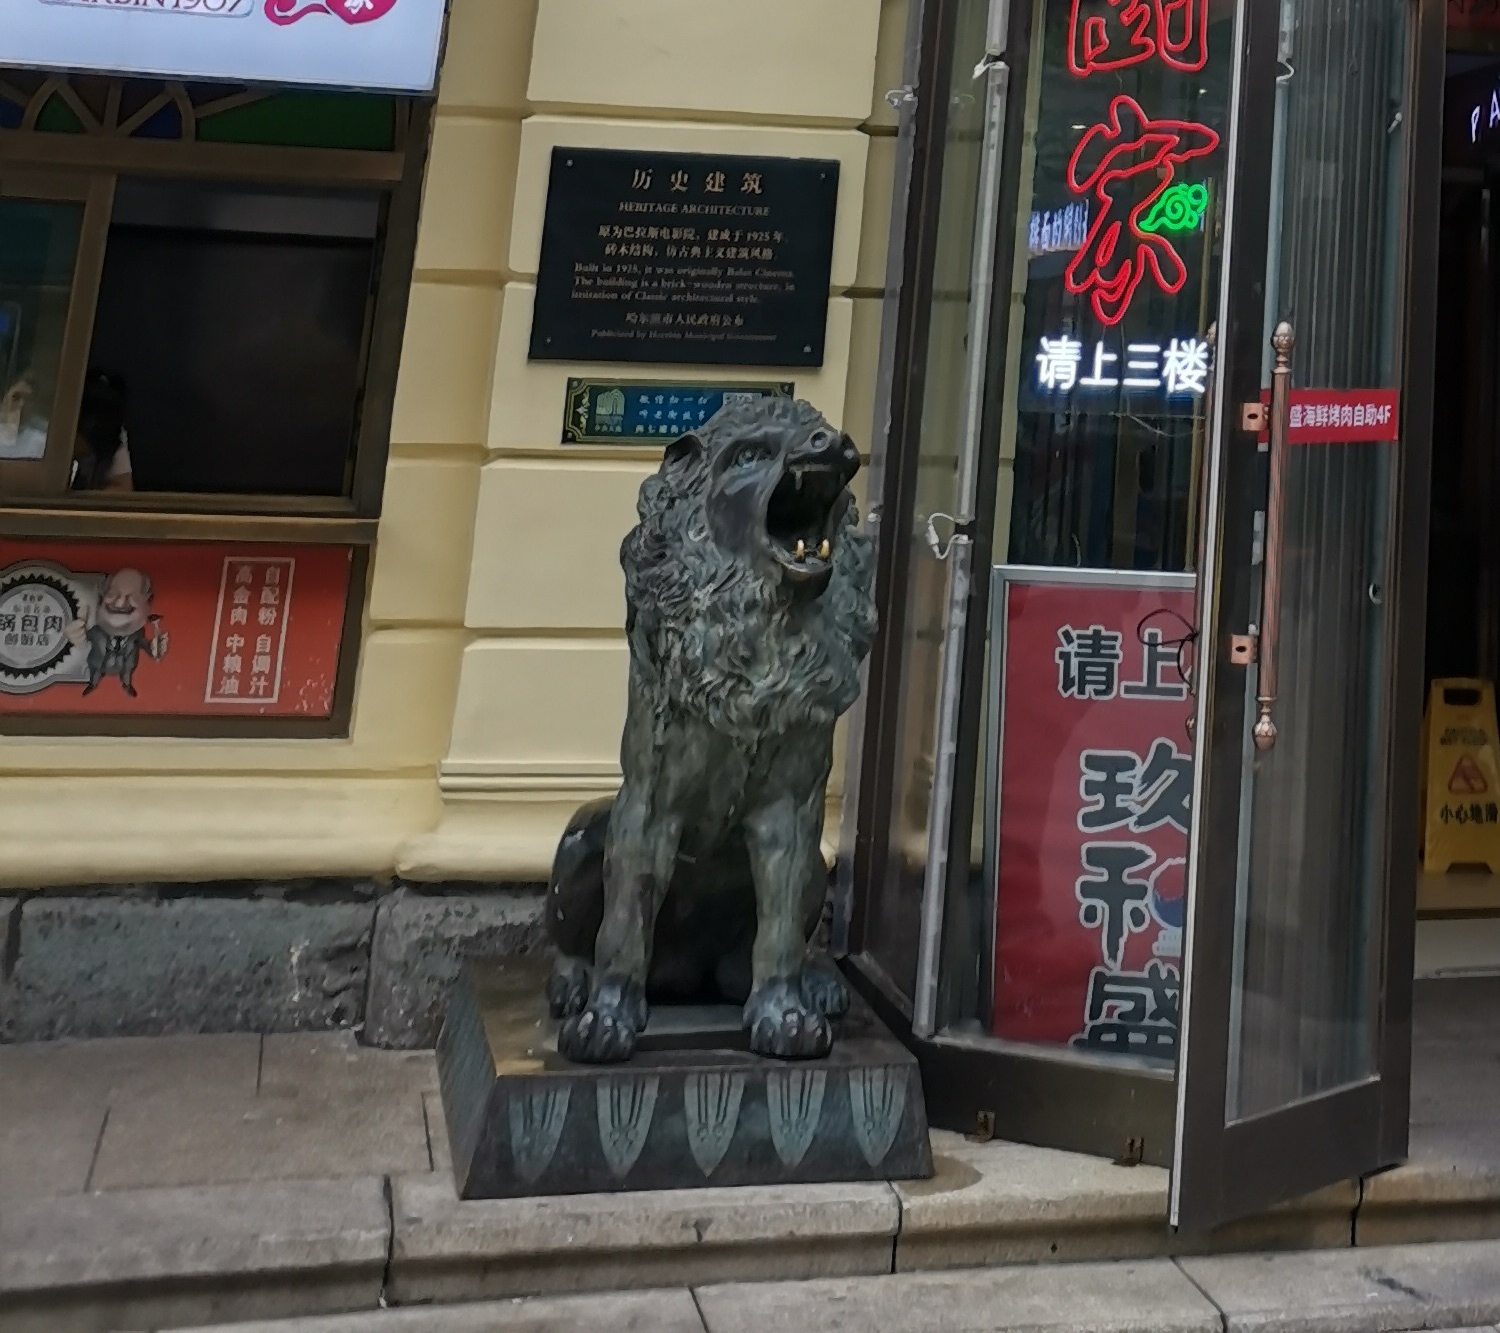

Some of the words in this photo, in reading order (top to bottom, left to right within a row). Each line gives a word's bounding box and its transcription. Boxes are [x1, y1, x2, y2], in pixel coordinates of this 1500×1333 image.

[632, 168, 764, 195] 历史建筑
[618, 201, 678, 214] HERITAGE
[681, 203, 770, 217] ARCHITECTURE
[1035, 334, 1209, 393] 请上三楼
[1055, 624, 1188, 701] 请上
